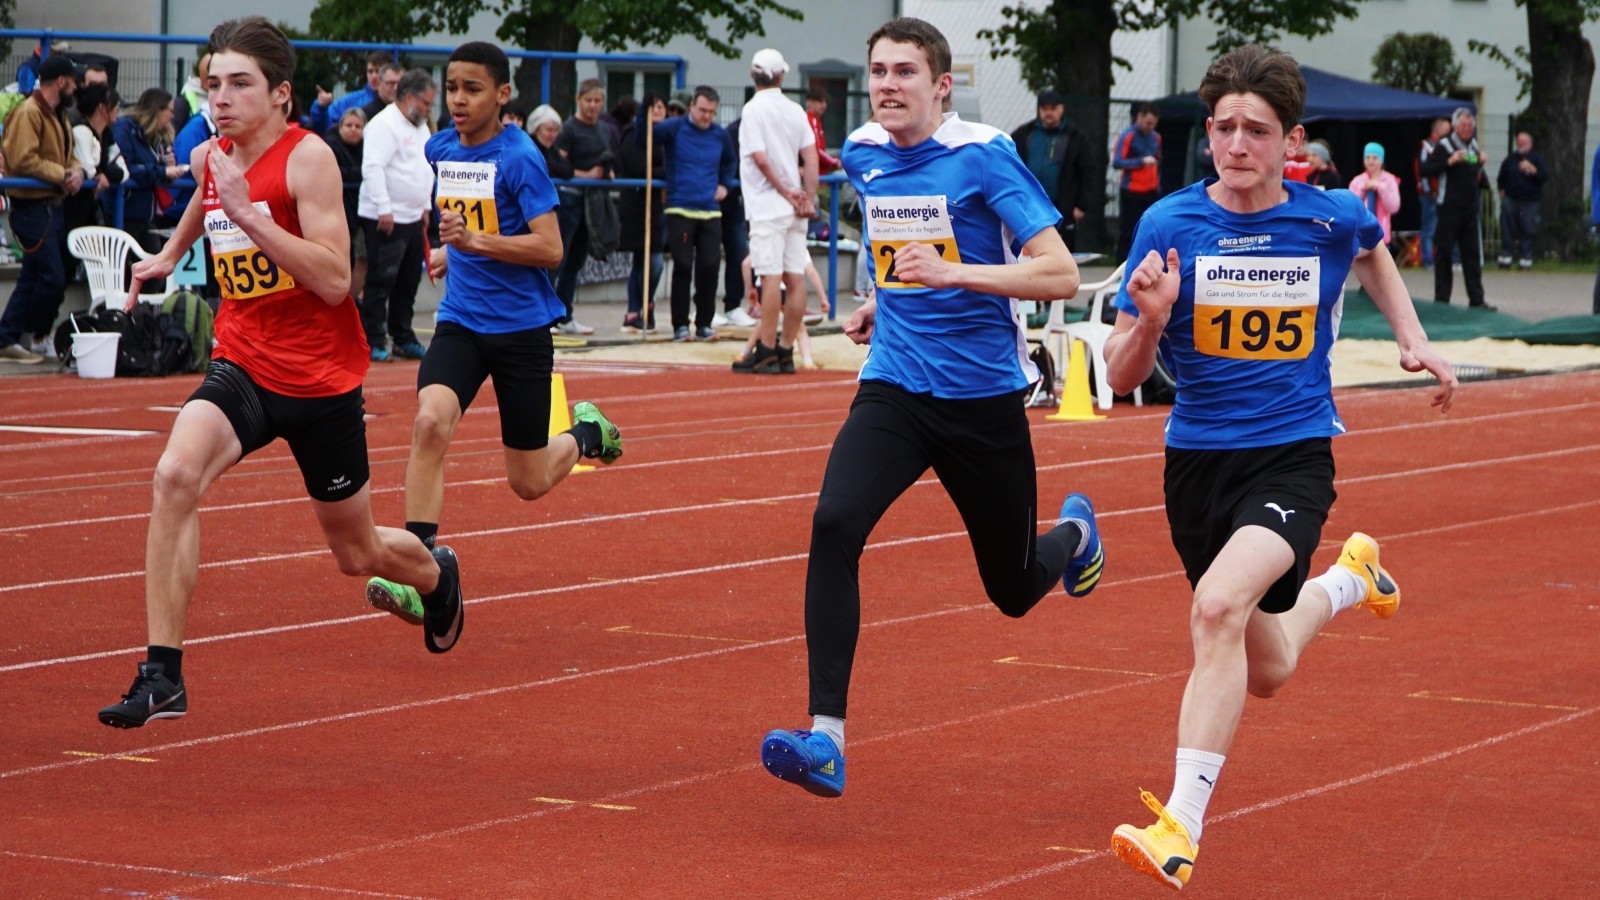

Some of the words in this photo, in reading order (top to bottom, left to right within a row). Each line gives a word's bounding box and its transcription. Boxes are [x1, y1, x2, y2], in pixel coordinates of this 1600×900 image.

[440, 167, 456, 179] ohra
[456, 169, 489, 183] energie
[443, 198, 485, 231] 31
[871, 205, 895, 219] ohra
[896, 204, 940, 222] energie
[208, 218, 228, 232] ohra
[1218, 237, 1238, 247] ohra
[1238, 233, 1272, 244] energie
[182, 247, 197, 271] 2
[218, 250, 279, 295] 359
[1207, 265, 1245, 281] ohra
[1247, 266, 1311, 286] energie
[1206, 289, 1220, 298] Gas
[1221, 290, 1235, 298] und
[1236, 290, 1258, 298] Strom
[1260, 290, 1270, 298] für
[1271, 290, 1283, 298] die
[1211, 308, 1304, 353] 195
